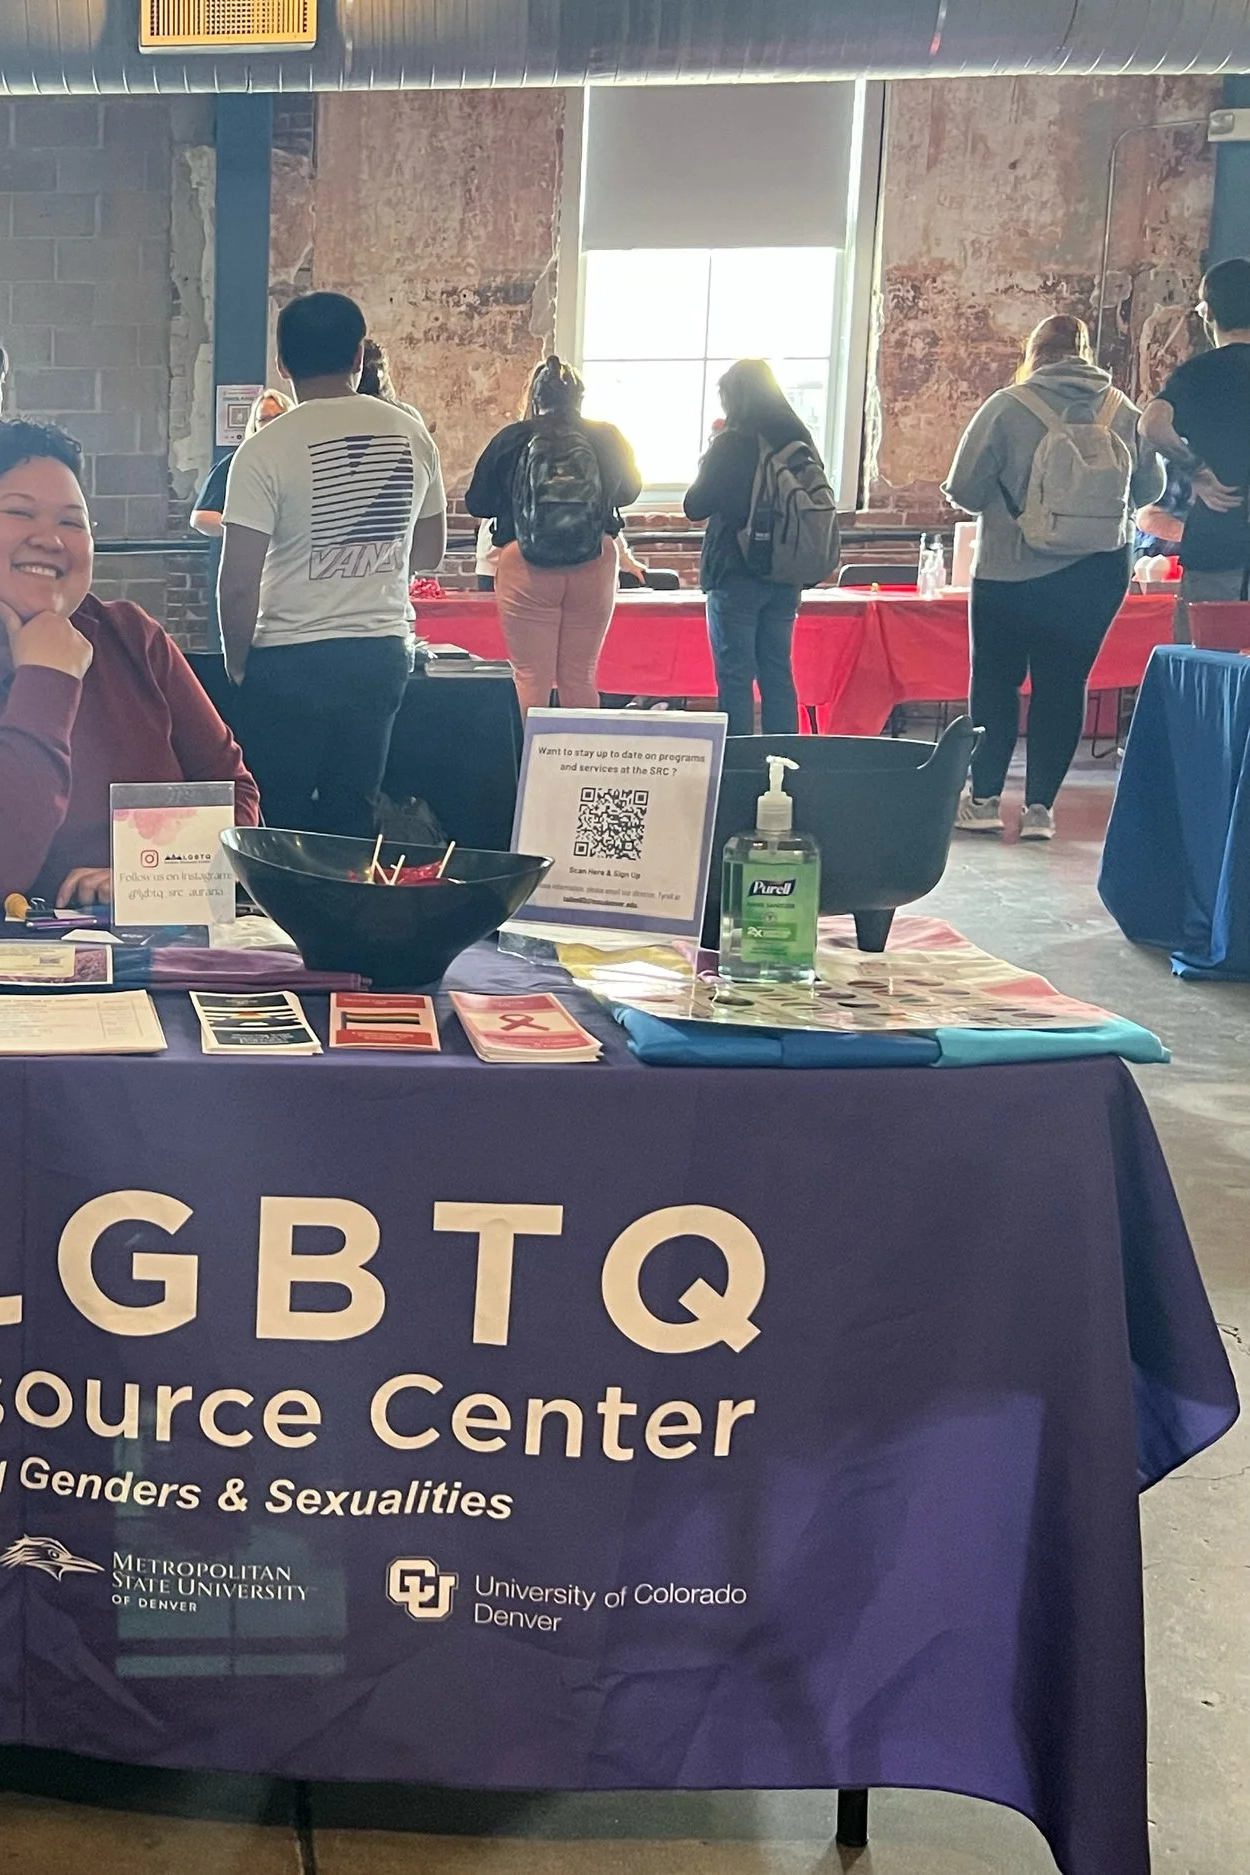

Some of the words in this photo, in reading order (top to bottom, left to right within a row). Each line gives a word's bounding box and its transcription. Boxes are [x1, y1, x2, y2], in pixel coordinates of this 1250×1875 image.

[538, 746, 561, 757] Want
[564, 748, 573, 757] to
[575, 749, 595, 759] stay
[597, 750, 608, 760] up
[610, 750, 620, 758] to
[622, 750, 643, 760] date
[645, 752, 657, 761] on
[659, 754, 706, 764] programs
[560, 763, 577, 773] and
[579, 765, 619, 774] services
[620, 766, 630, 774] at
[632, 766, 648, 775] the
[649, 767, 670, 776] SRC
[119, 871, 151, 882] Follow
[153, 873, 164, 881] us
[166, 872, 179, 881] on
[569, 866, 587, 875] Scan
[588, 868, 605, 877] Here
[614, 870, 629, 879] Sign
[630, 871, 641, 880] Up
[370, 1373, 756, 1461] Center
[20, 1456, 202, 1510] Genders
[217, 1478, 248, 1512] &
[265, 1479, 514, 1520] Sexualities
[113, 1551, 292, 1581] METROPOLITAN
[112, 1571, 170, 1594] STATE
[178, 1578, 309, 1601] UNIVERSITY
[474, 1575, 597, 1611] University
[604, 1586, 629, 1609] of
[634, 1582, 748, 1605] Colorado
[112, 1594, 131, 1606] OF
[139, 1597, 198, 1612] DENVER
[474, 1603, 562, 1632] Denver
